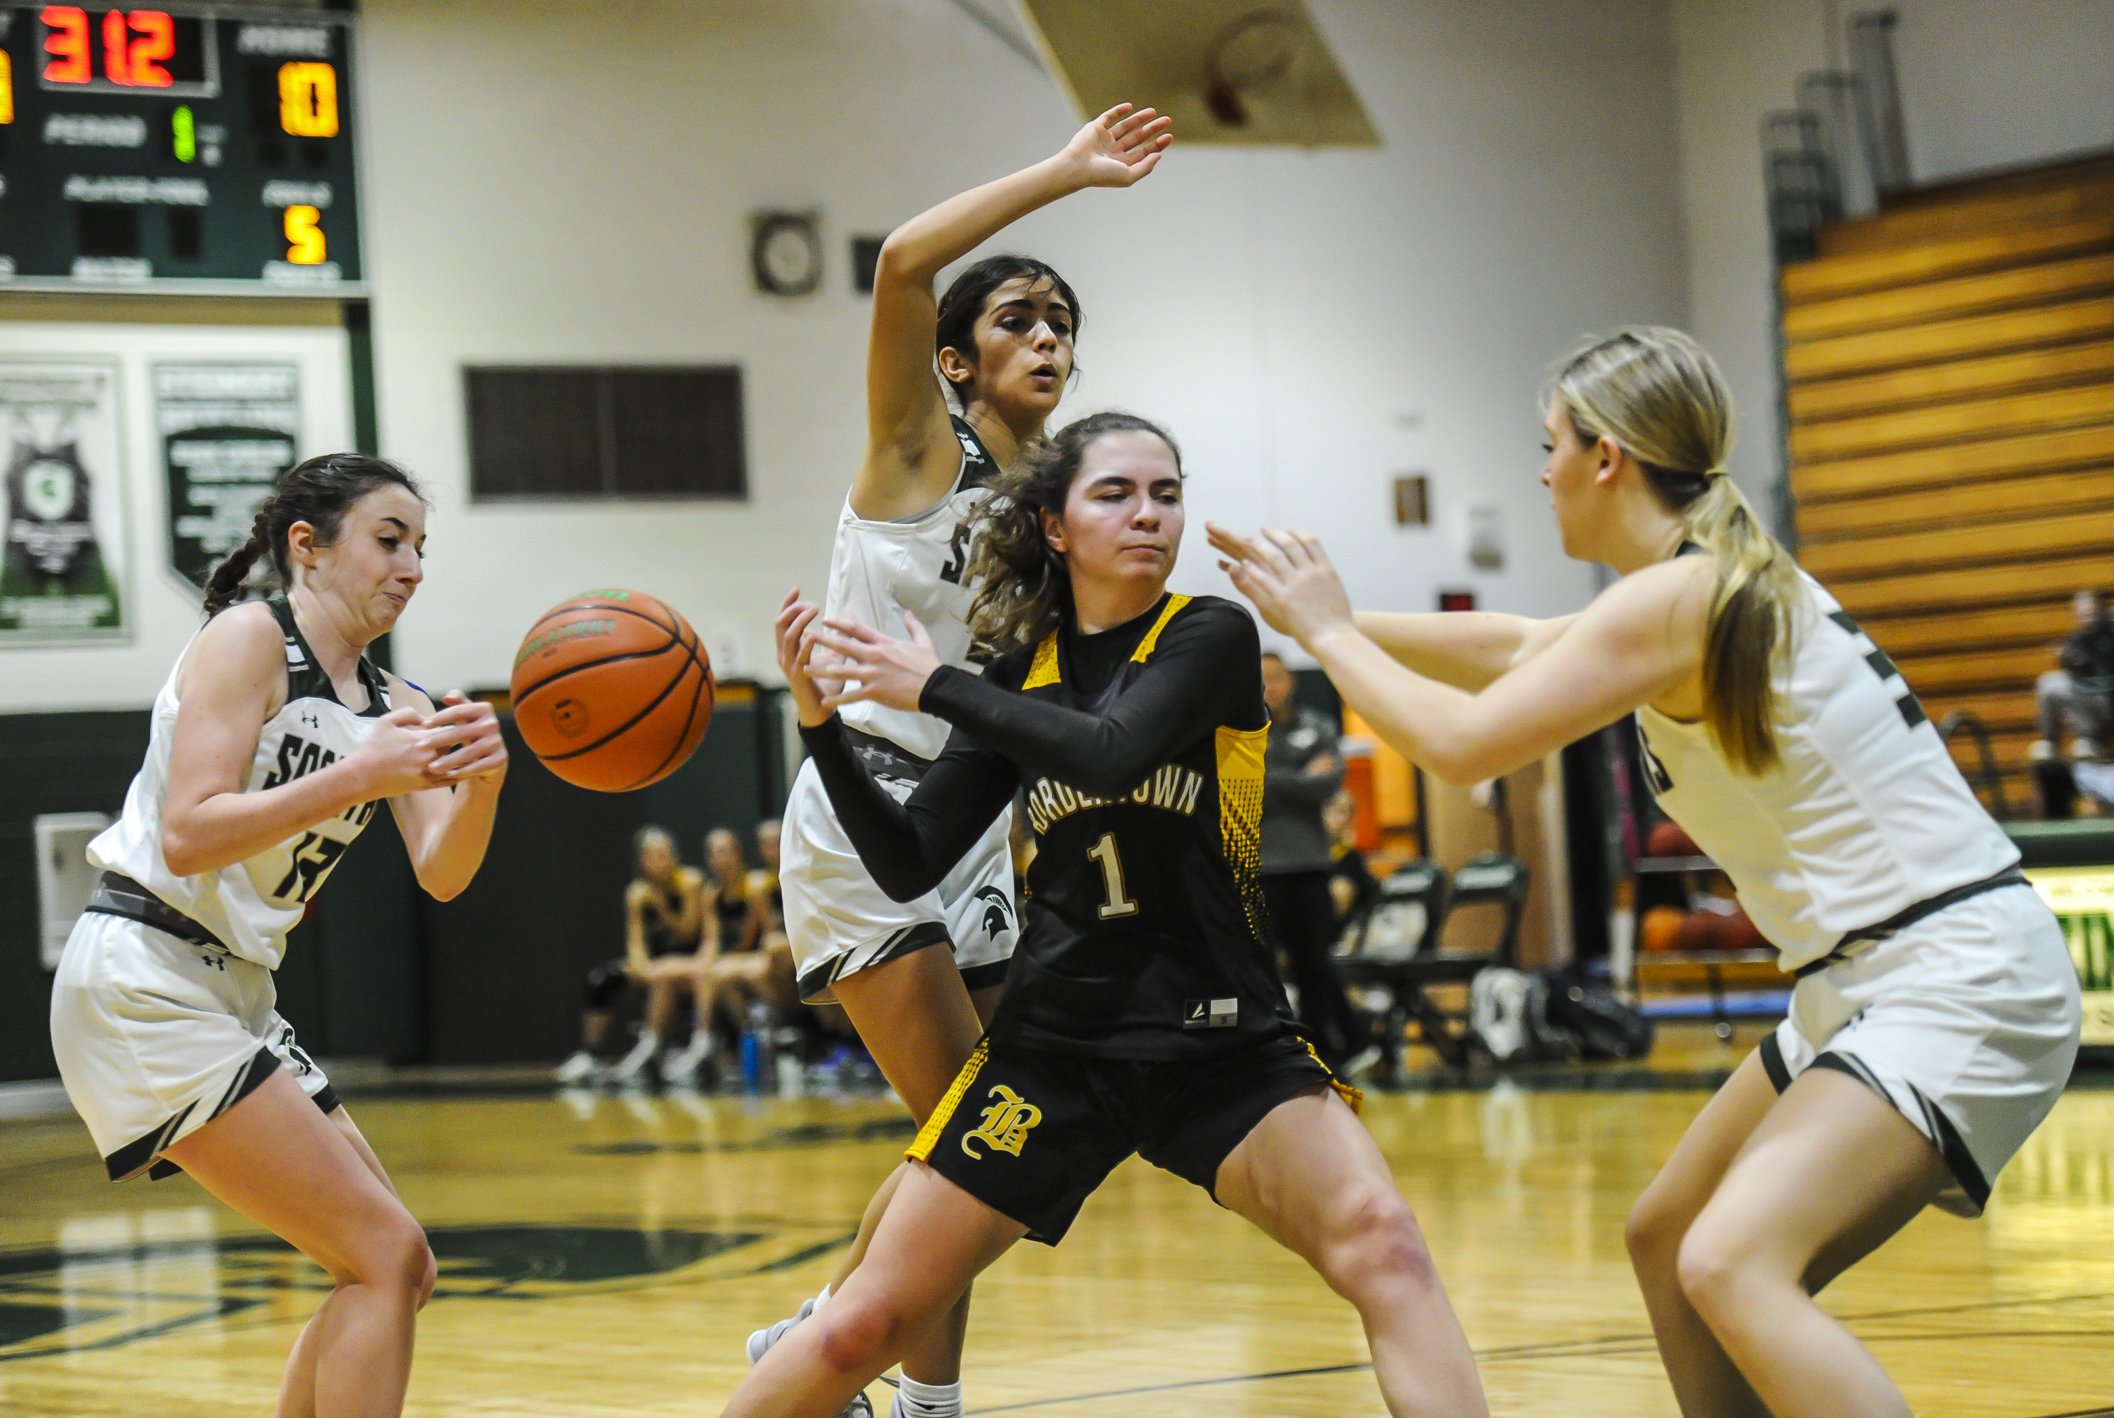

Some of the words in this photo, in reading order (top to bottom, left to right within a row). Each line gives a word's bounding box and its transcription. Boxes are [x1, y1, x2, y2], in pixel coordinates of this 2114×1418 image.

[172, 105, 196, 163] 1
[283, 204, 327, 265] 5
[1087, 832, 1139, 919] 1
[962, 1085, 1042, 1160] B
